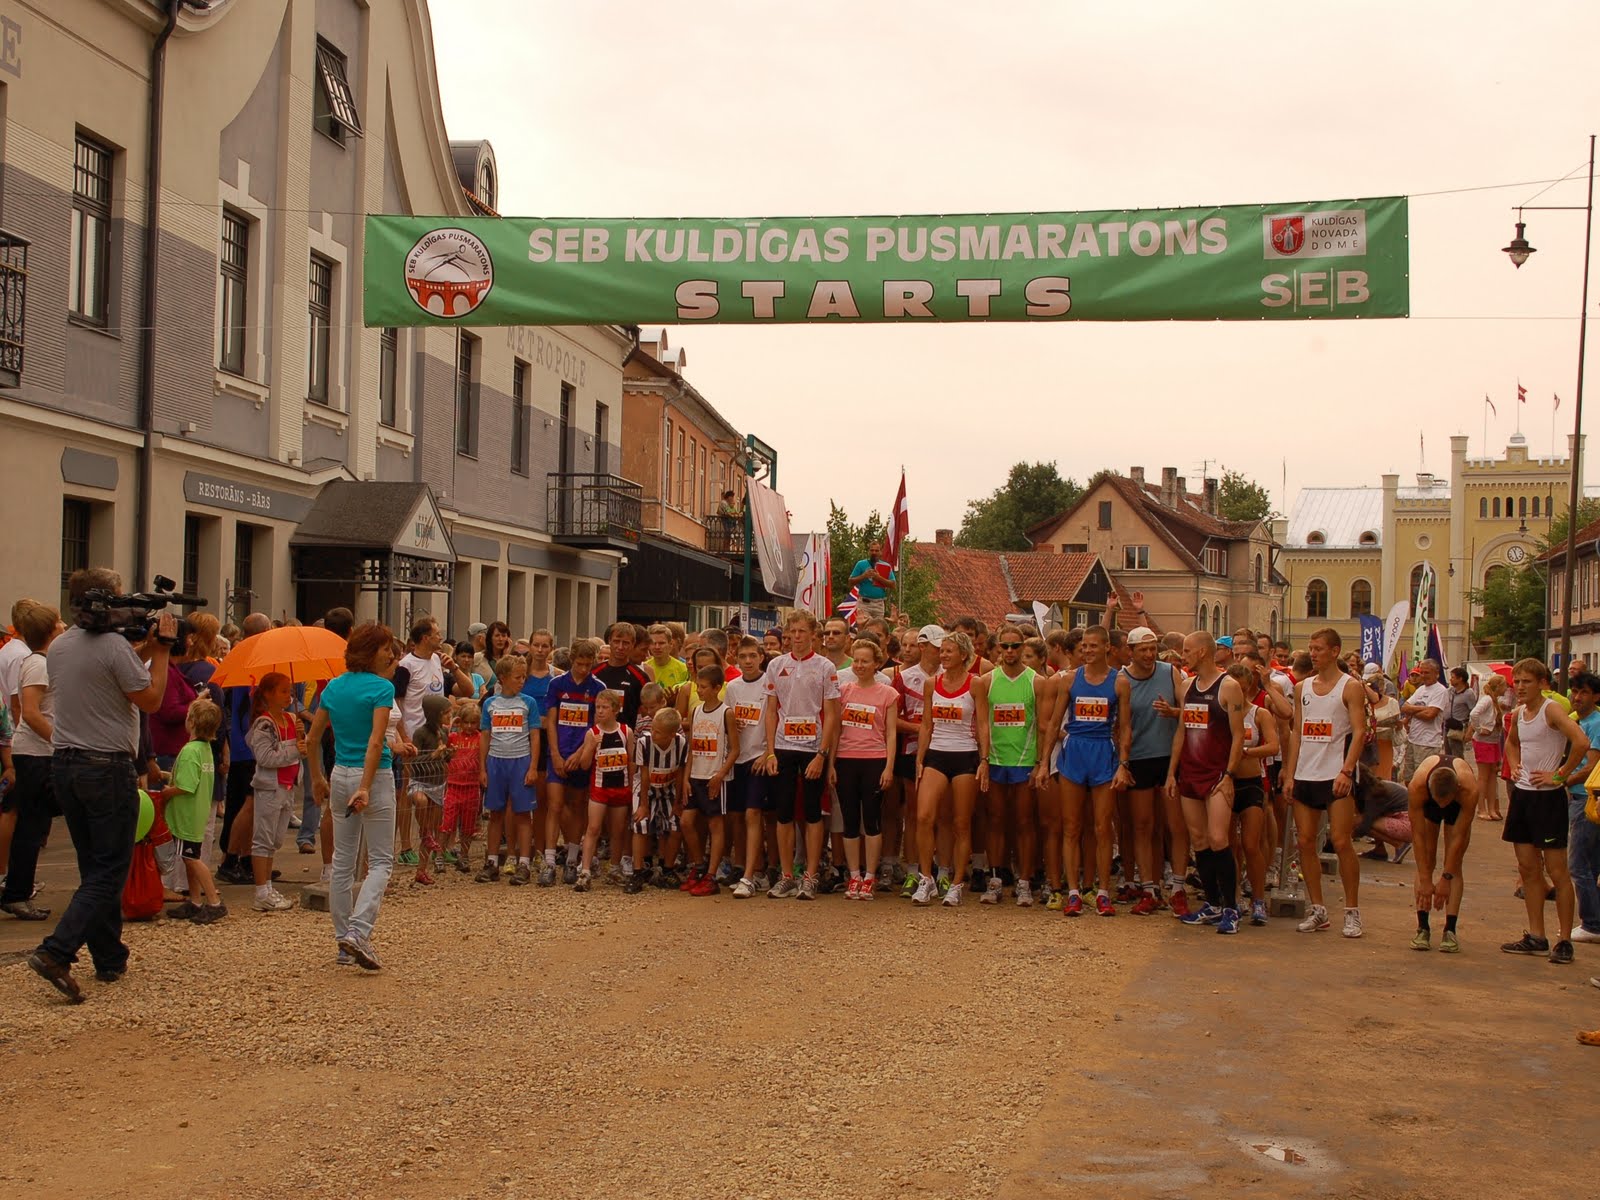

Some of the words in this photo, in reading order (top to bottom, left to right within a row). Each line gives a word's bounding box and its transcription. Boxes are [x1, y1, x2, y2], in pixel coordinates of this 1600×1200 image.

[1310, 214, 1358, 227] KULDĪGAS
[1311, 228, 1359, 239] NOVADA
[528, 227, 609, 263] SEB
[624, 221, 850, 263] KULDĪGAS
[865, 217, 1228, 262] PUSMARATONS
[1311, 239, 1359, 250] DOME
[408, 258, 417, 274] SEB
[413, 233, 447, 259] KULDĪGAS
[448, 233, 490, 276] PUSMARATONS
[674, 276, 1072, 320] STARTS
[507, 325, 586, 388] METROPOLE
[198, 481, 244, 504] RESTORĀNS
[563, 710, 584, 721] 474
[737, 708, 757, 720] 497
[848, 710, 870, 723] 564
[936, 707, 958, 719] 576
[998, 710, 1021, 721] 554
[1080, 705, 1103, 717] 649
[1184, 711, 1204, 722] 635
[497, 715, 519, 727] 776
[789, 723, 812, 736] 565
[1307, 723, 1327, 735] 652
[602, 755, 624, 767] 473
